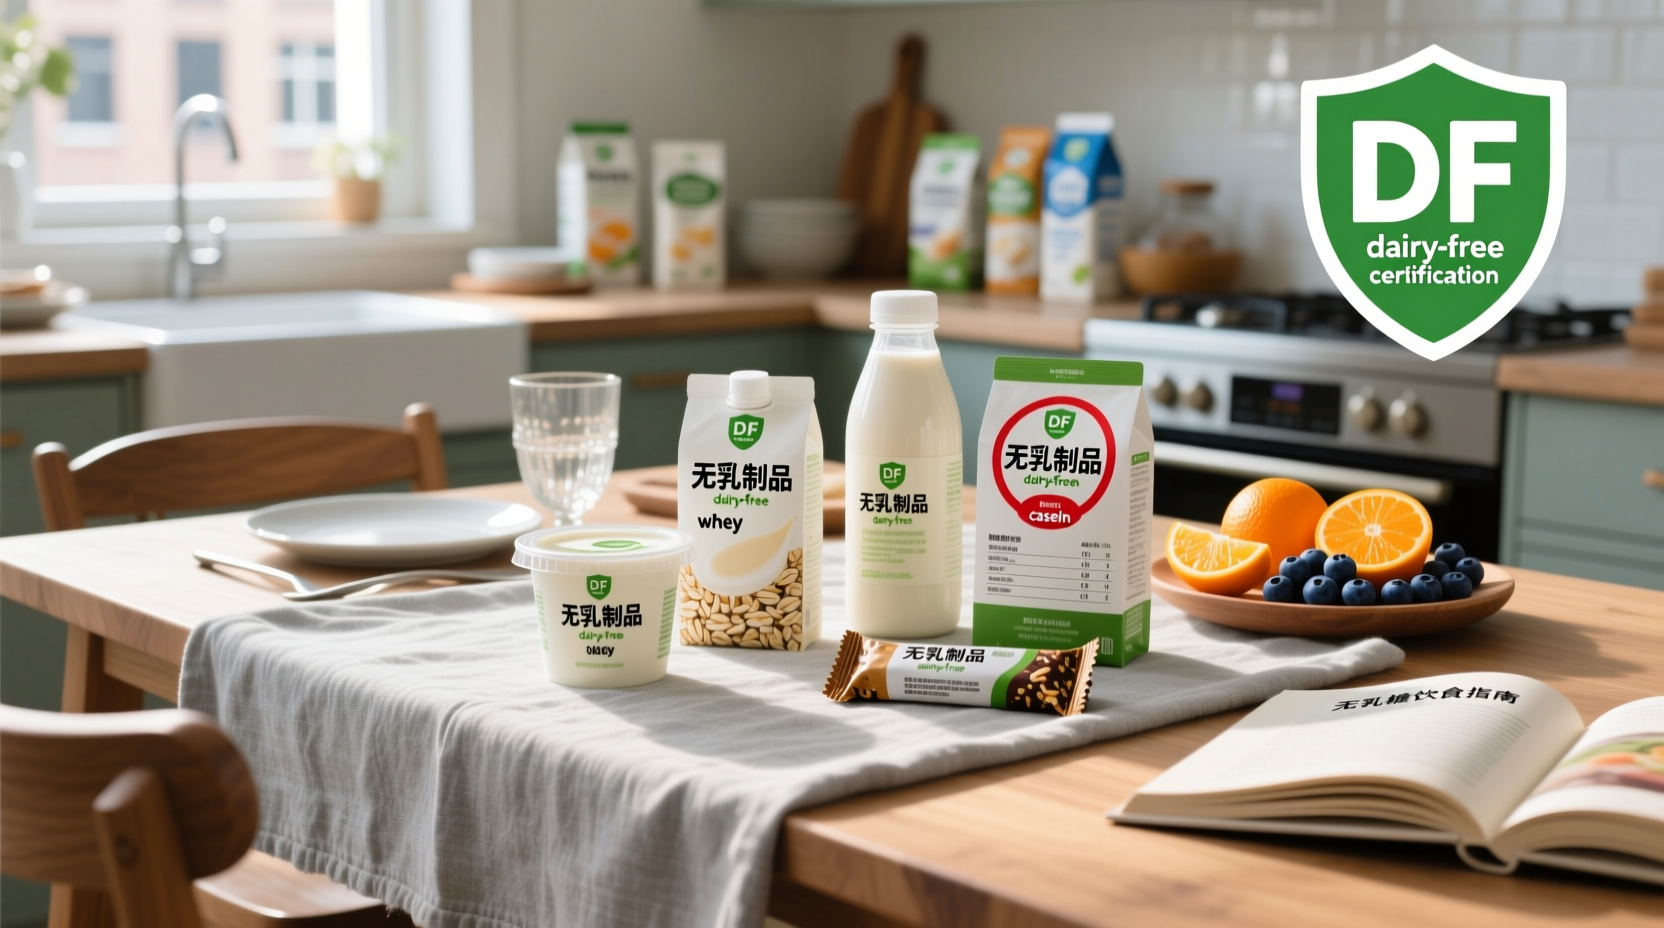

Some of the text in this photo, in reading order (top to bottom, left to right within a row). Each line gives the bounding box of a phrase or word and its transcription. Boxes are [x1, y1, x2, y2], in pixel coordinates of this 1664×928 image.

[733, 421, 759, 436] DF
[1048, 414, 1072, 429] DF
[1003, 444, 1102, 475] 无乳制品
[691, 461, 793, 492] 无乳制品
[883, 467, 902, 479] DF
[859, 492, 929, 514] 无乳制品
[697, 513, 743, 534] whey
[590, 579, 608, 591] DF
[561, 603, 642, 628] 无乳制品
